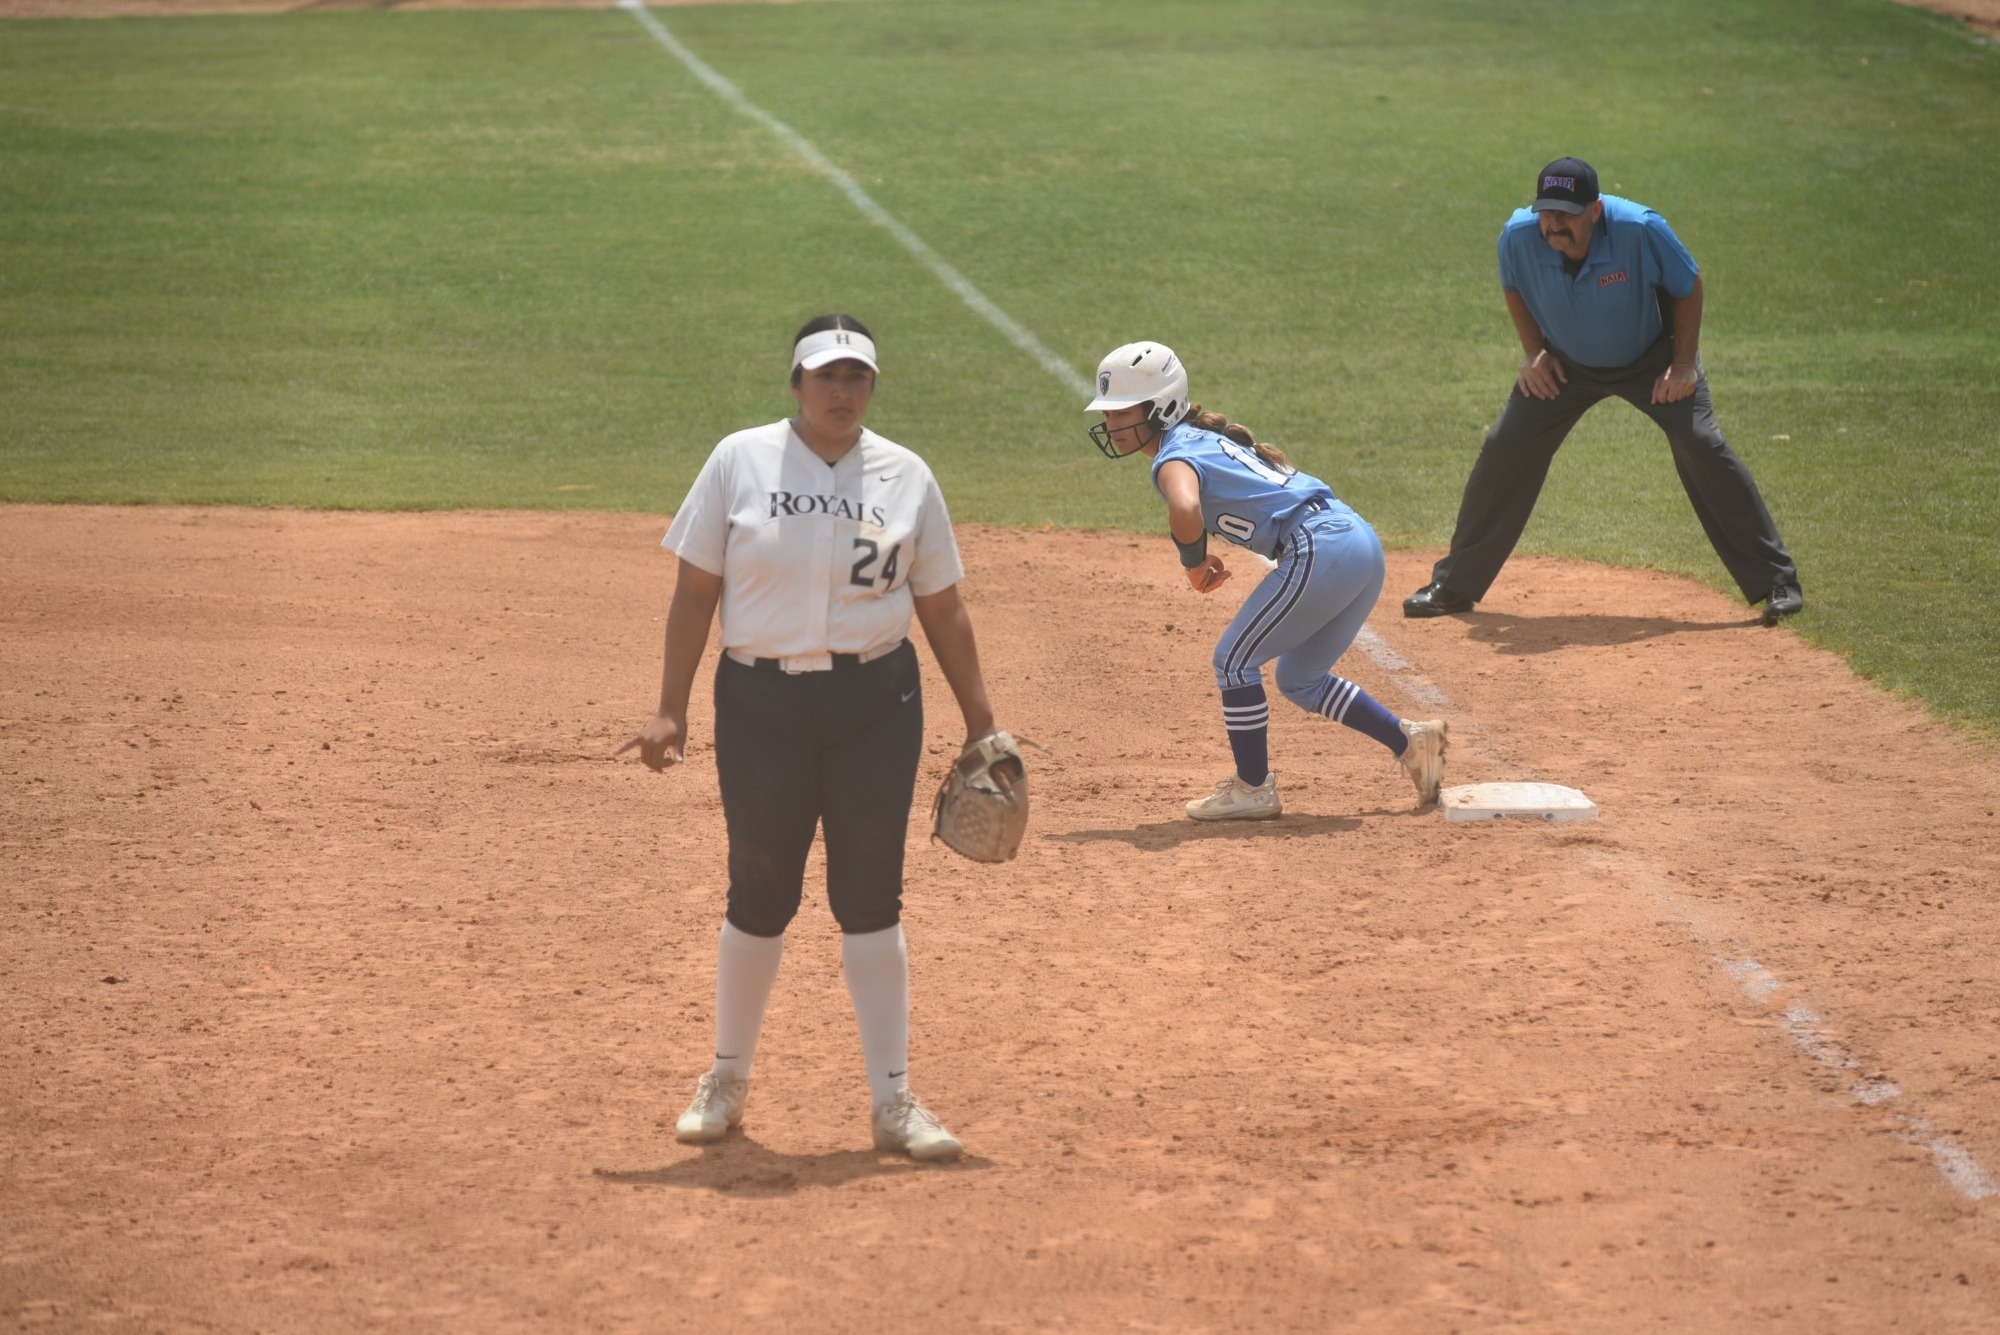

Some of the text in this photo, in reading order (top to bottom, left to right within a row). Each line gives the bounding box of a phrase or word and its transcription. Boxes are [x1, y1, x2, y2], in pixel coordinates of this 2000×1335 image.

[1544, 176, 1574, 191] NAIA
[1600, 272, 1626, 287] NAIA
[835, 333, 850, 344] H
[769, 491, 885, 528] ROYALS
[850, 537, 901, 591] 24
